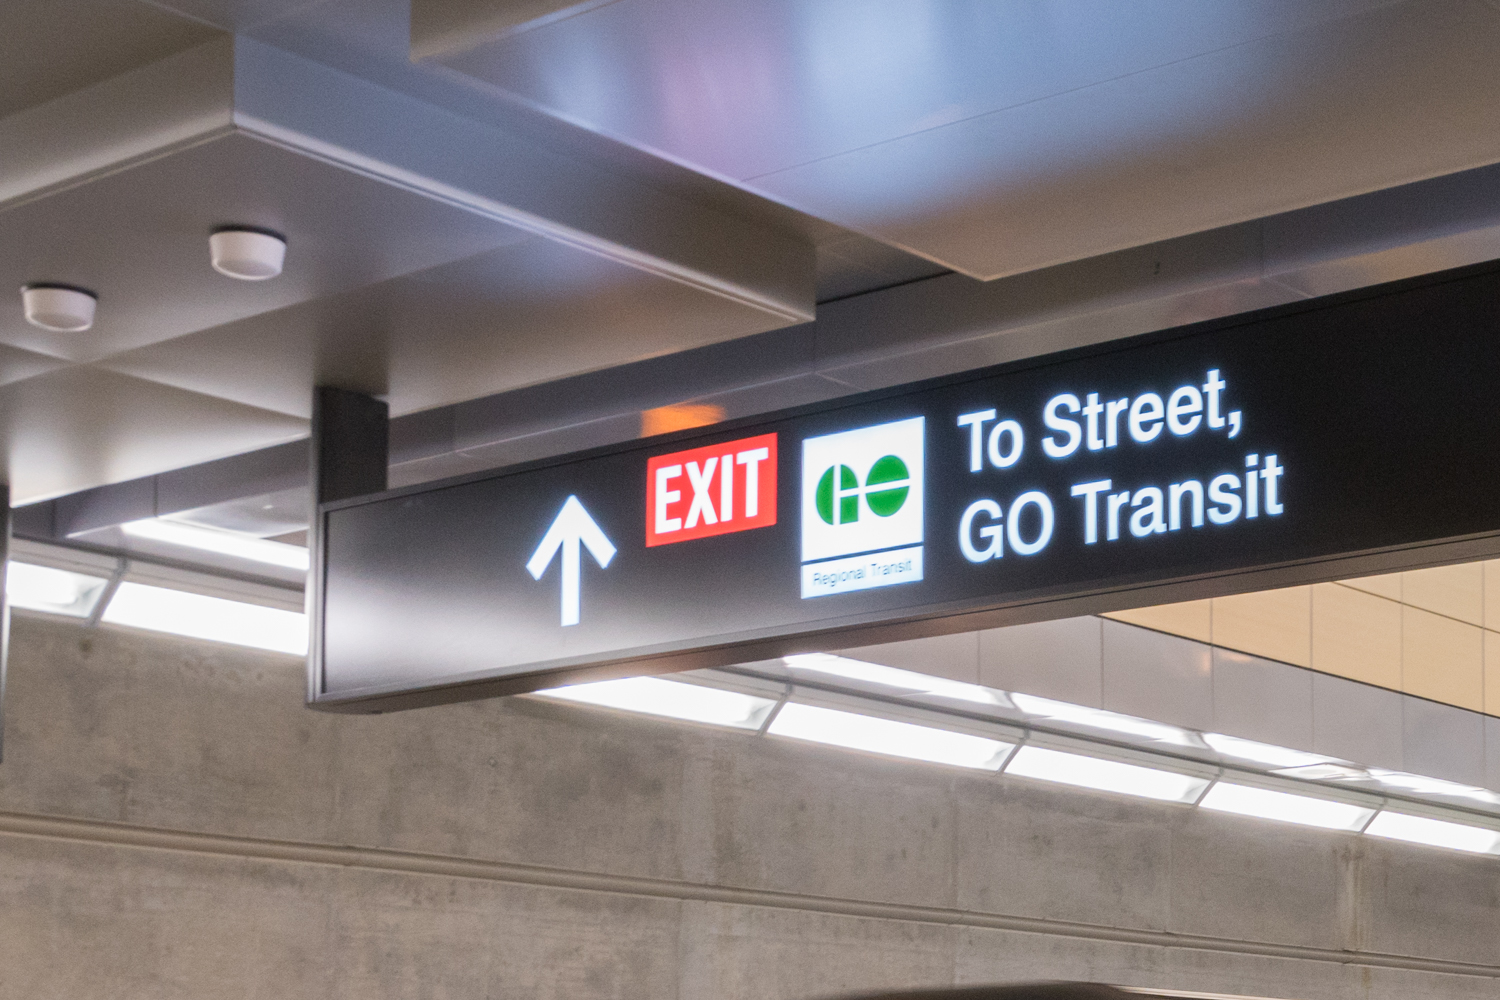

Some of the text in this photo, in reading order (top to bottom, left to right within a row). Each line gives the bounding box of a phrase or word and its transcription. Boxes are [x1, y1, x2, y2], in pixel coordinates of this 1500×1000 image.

[956, 368, 1243, 474] To Street,
[653, 445, 770, 536] EXIT
[957, 453, 1285, 564] GO Transit
[812, 558, 912, 588] Regional Transit
